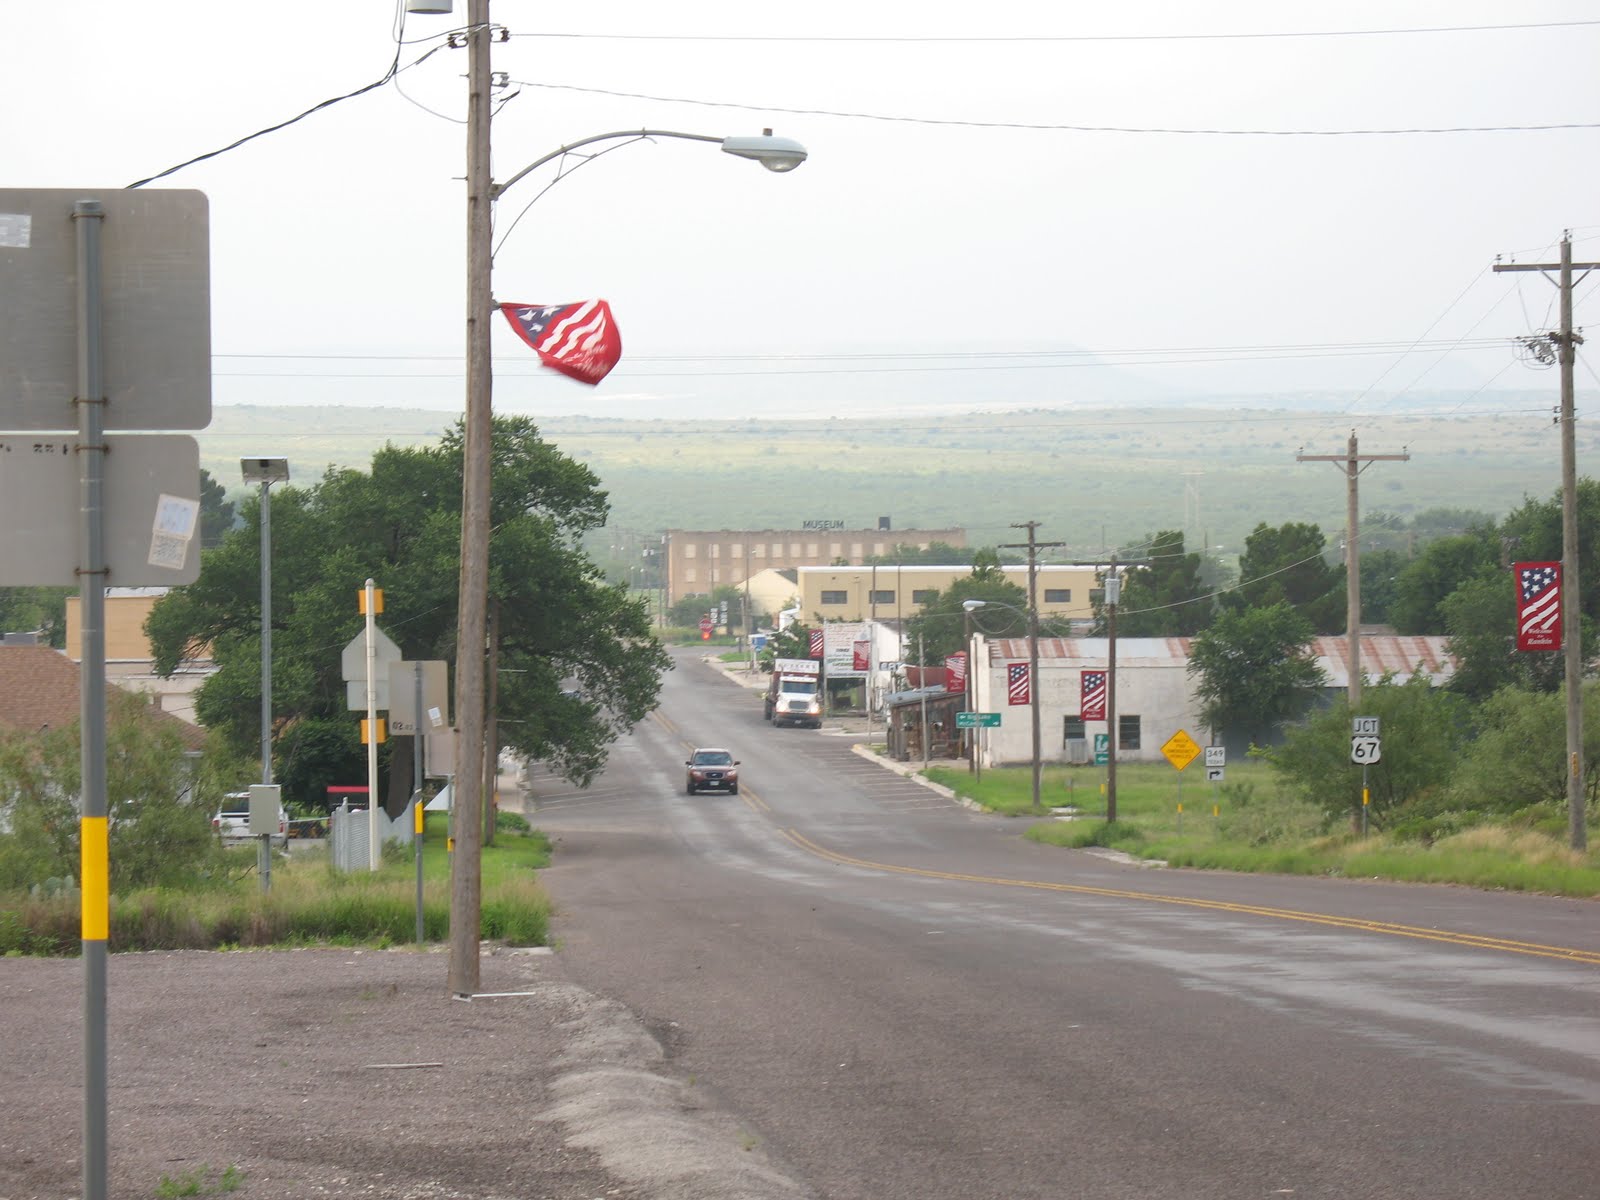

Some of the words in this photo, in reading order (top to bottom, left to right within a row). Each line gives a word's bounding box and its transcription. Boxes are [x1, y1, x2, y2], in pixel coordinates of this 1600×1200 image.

[803, 520, 844, 529] MUSEUM
[1355, 720, 1377, 732] JCT
[1207, 749, 1224, 757] 349
[1355, 742, 1377, 758] 67
